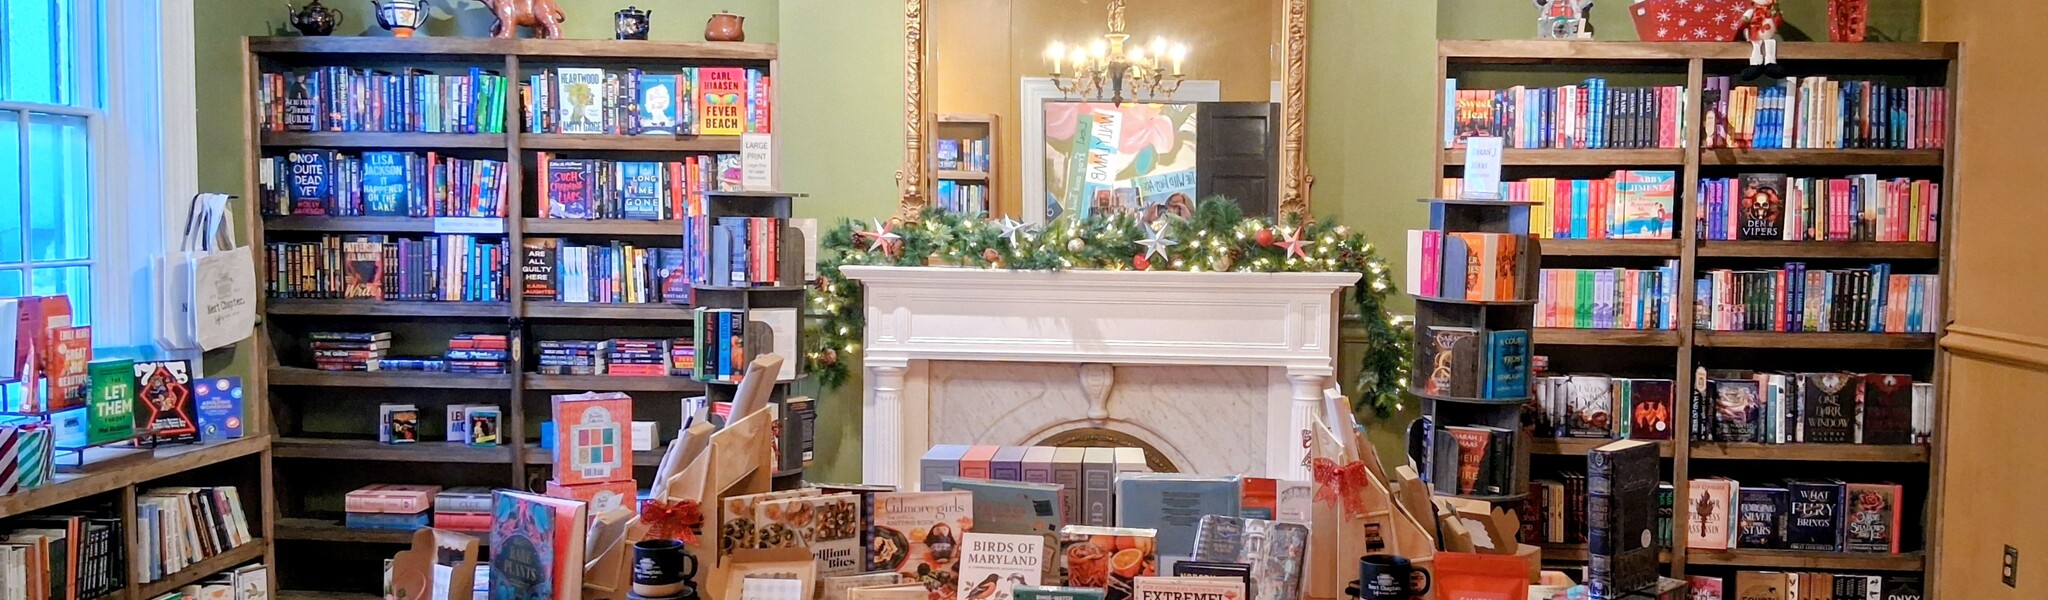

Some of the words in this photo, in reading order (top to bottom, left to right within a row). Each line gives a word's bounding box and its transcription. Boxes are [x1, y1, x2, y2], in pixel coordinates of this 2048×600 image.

[561, 73, 600, 85] HEARTWOOD
[711, 71, 731, 80] CARL
[704, 81, 739, 90] HIAASEN
[1459, 98, 1492, 108] Sweet
[706, 105, 737, 117] FEVER
[1462, 110, 1488, 119] Heat
[705, 118, 738, 129] BEACH
[745, 141, 768, 149] LARGE
[297, 153, 319, 164] NOT
[372, 155, 394, 165] LISA
[746, 152, 767, 160] PRINT
[293, 164, 322, 175] QUITE
[364, 163, 403, 176] JACKSON
[295, 175, 322, 186] DEAD
[380, 177, 388, 185] IT
[1639, 176, 1663, 184] ABBY
[300, 186, 318, 196] YET
[364, 183, 404, 193] HAPPENED
[627, 186, 654, 194] TIME
[1630, 184, 1672, 192] JIMENEZ
[368, 193, 379, 201] ON
[382, 194, 397, 204] THE
[625, 198, 659, 206] GONE
[372, 202, 396, 212] LAKE
[1742, 228, 1778, 236] VIPERS
[344, 242, 382, 252] PATTERSON
[64, 386, 80, 399] LIFE
[104, 384, 127, 401] LET
[1818, 394, 1839, 405] ONE
[96, 398, 133, 417] THEM
[1816, 406, 1842, 417] DARK
[1808, 418, 1850, 428] WINDOW
[1800, 490, 1830, 501] WHAT
[884, 497, 935, 514] Gilmore
[936, 497, 965, 520] girls
[1741, 504, 1777, 512] FORGING
[1792, 502, 1836, 516] FURY
[1743, 512, 1772, 522] SILVER
[1797, 518, 1830, 527] BRINGS
[1744, 526, 1771, 535] STARS
[973, 541, 1014, 553] BIRDS
[1018, 543, 1036, 554] OF
[813, 548, 851, 562] rilliant
[968, 554, 1038, 566] MARYLAND
[828, 558, 856, 568] Bites
[504, 560, 537, 581] PLANTS
